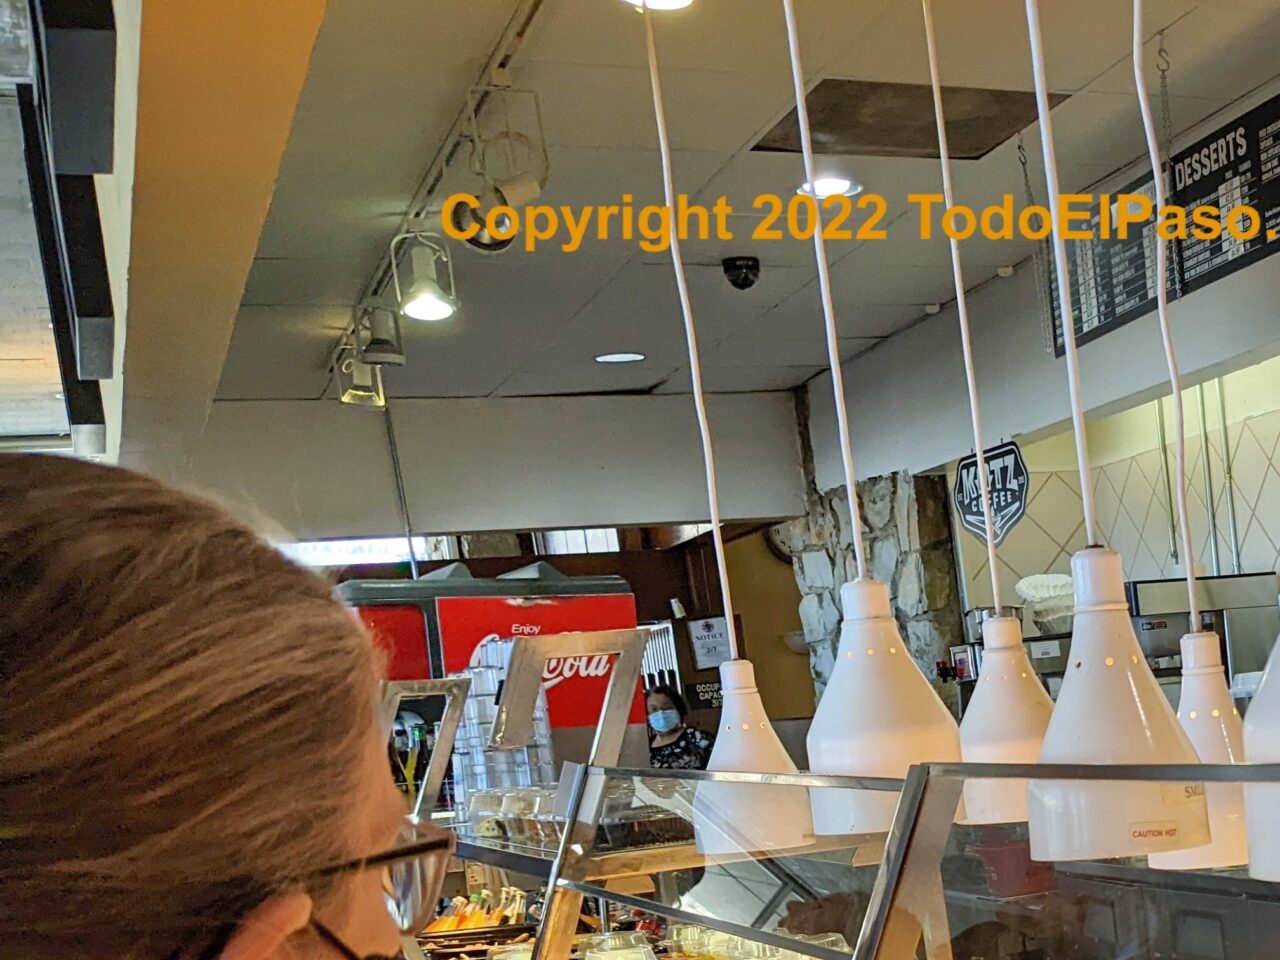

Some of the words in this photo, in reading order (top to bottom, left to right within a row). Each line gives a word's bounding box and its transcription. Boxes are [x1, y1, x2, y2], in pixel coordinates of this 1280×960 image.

[1174, 126, 1247, 191] DESSERTS
[512, 624, 541, 634] Enjoy
[695, 632, 724, 641] NOTICE
[1132, 830, 1163, 838] CAUTION
[1165, 828, 1177, 837] HOT
